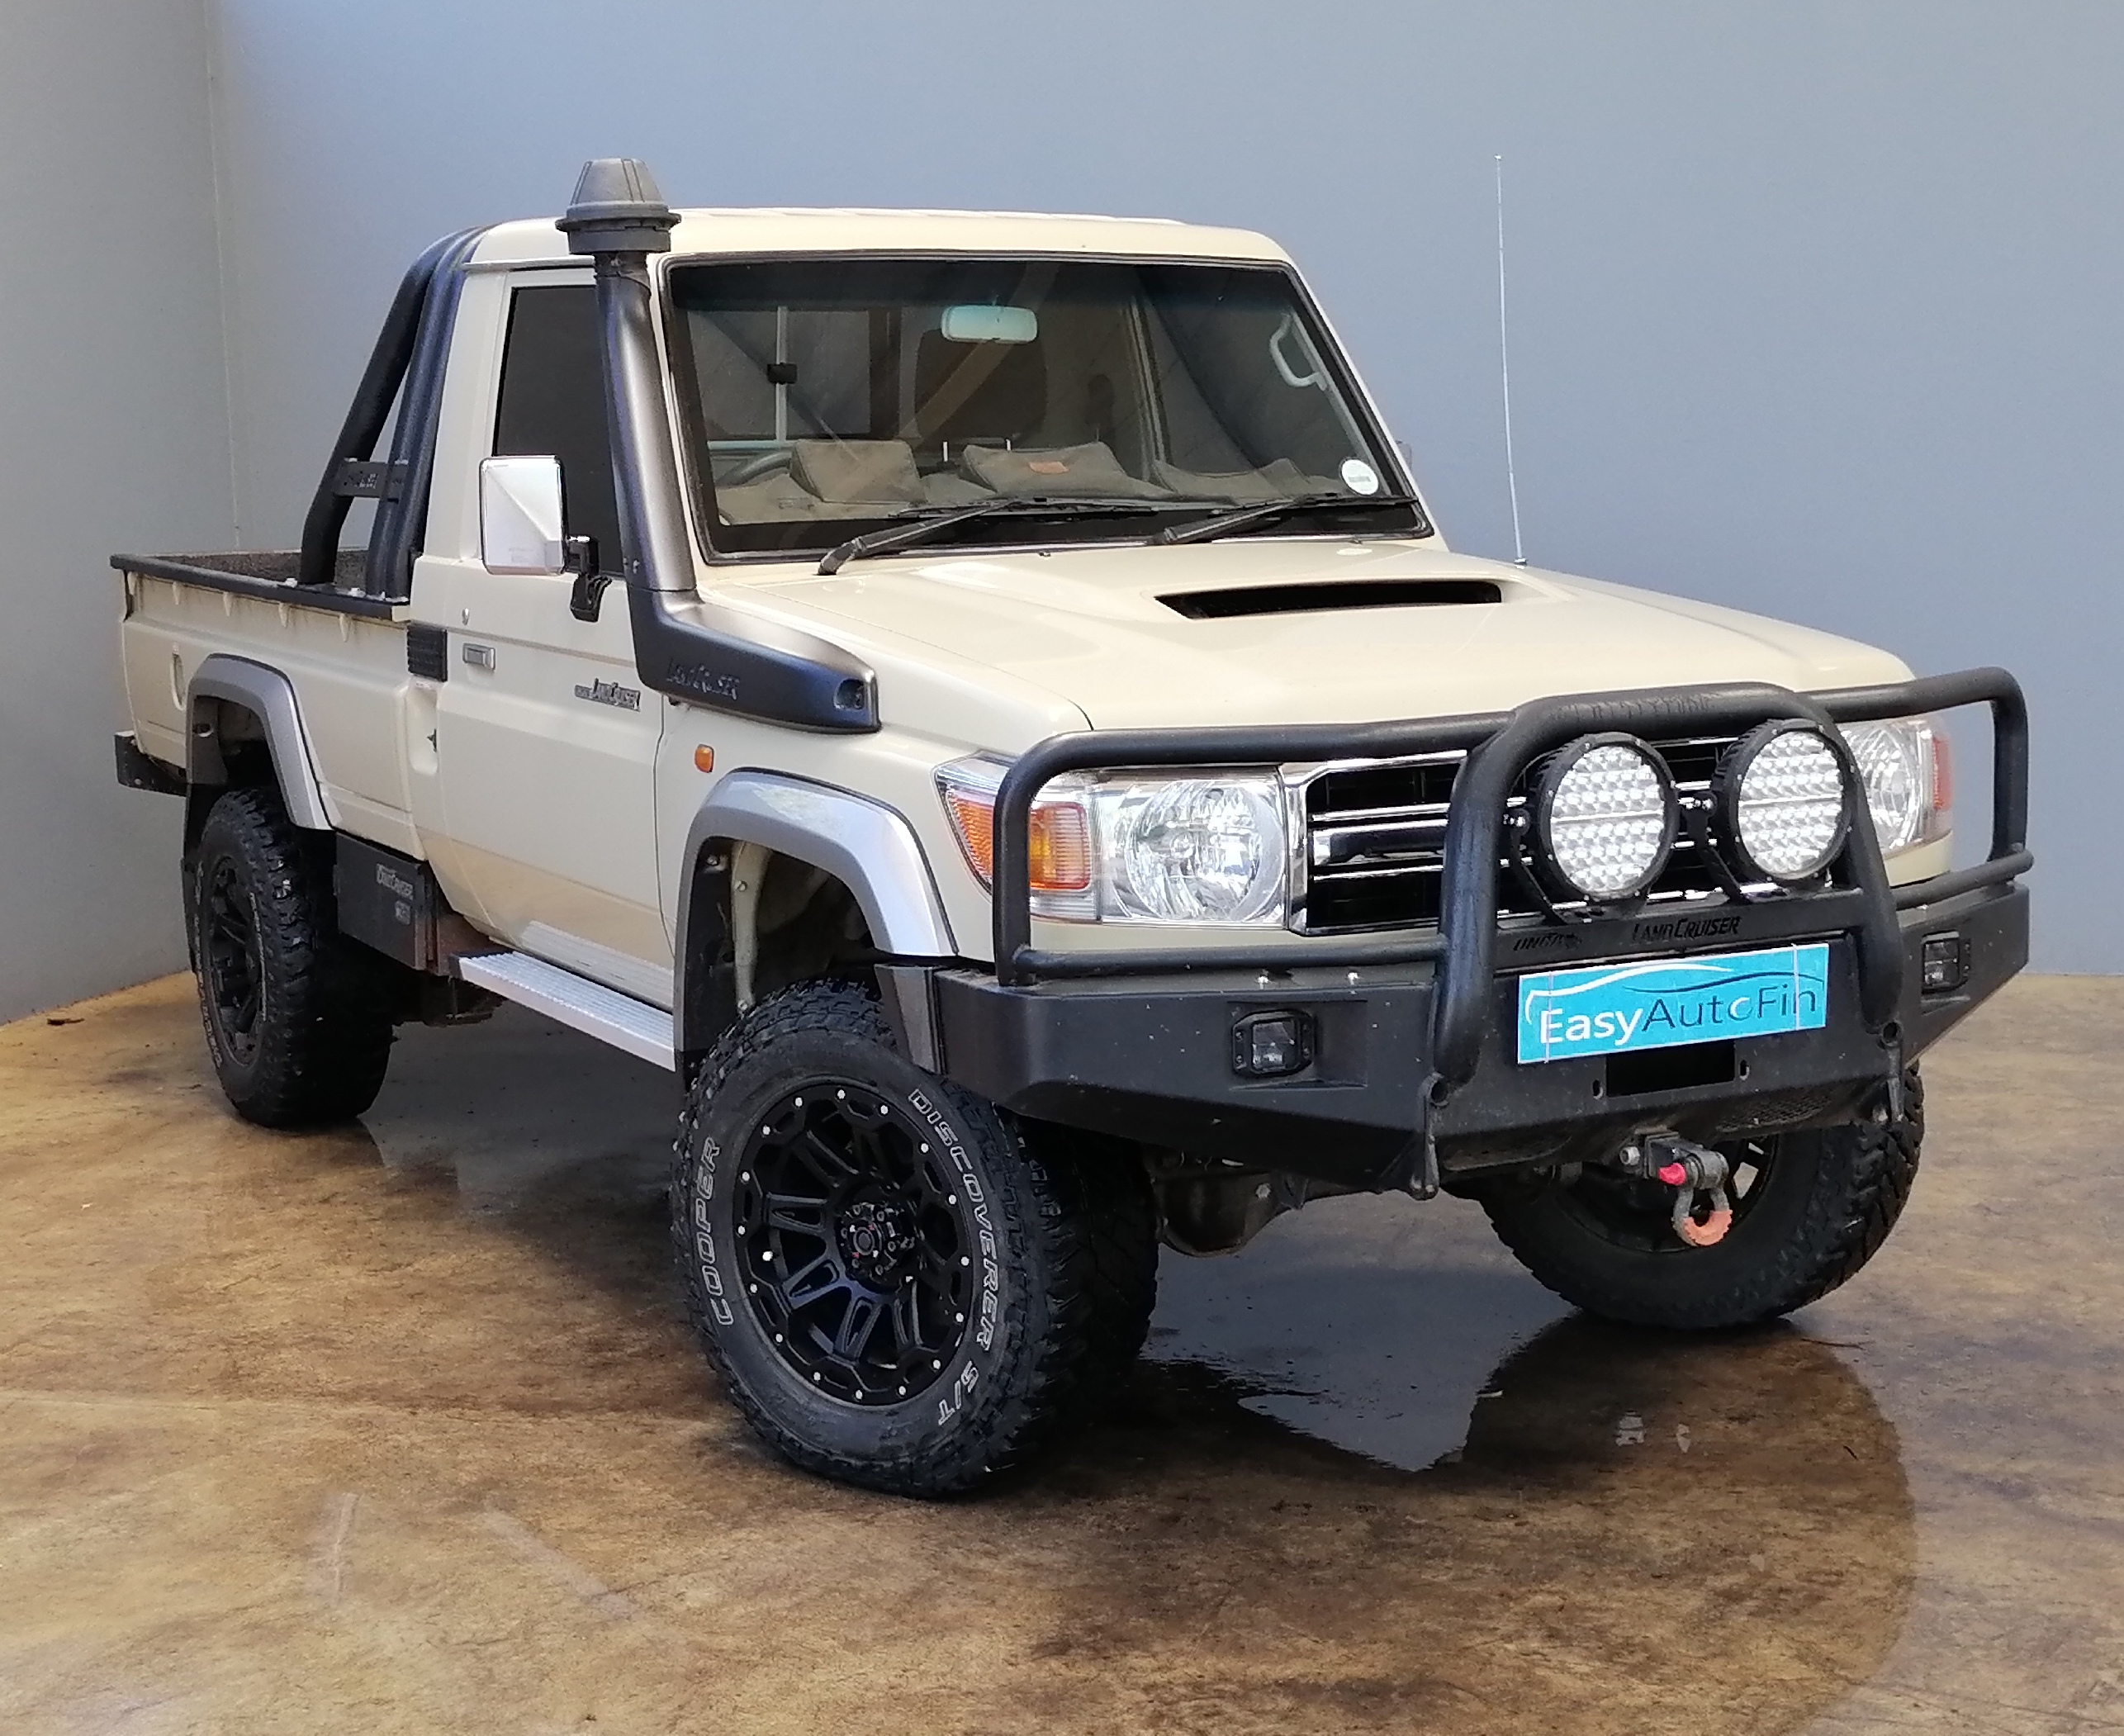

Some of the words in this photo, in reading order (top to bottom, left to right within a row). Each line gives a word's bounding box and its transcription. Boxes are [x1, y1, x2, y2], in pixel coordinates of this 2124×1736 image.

[1539, 983, 1817, 1046] EasyAutoFin
[695, 1136, 734, 1326] COOPER
[908, 1088, 999, 1352] DISCOVERER
